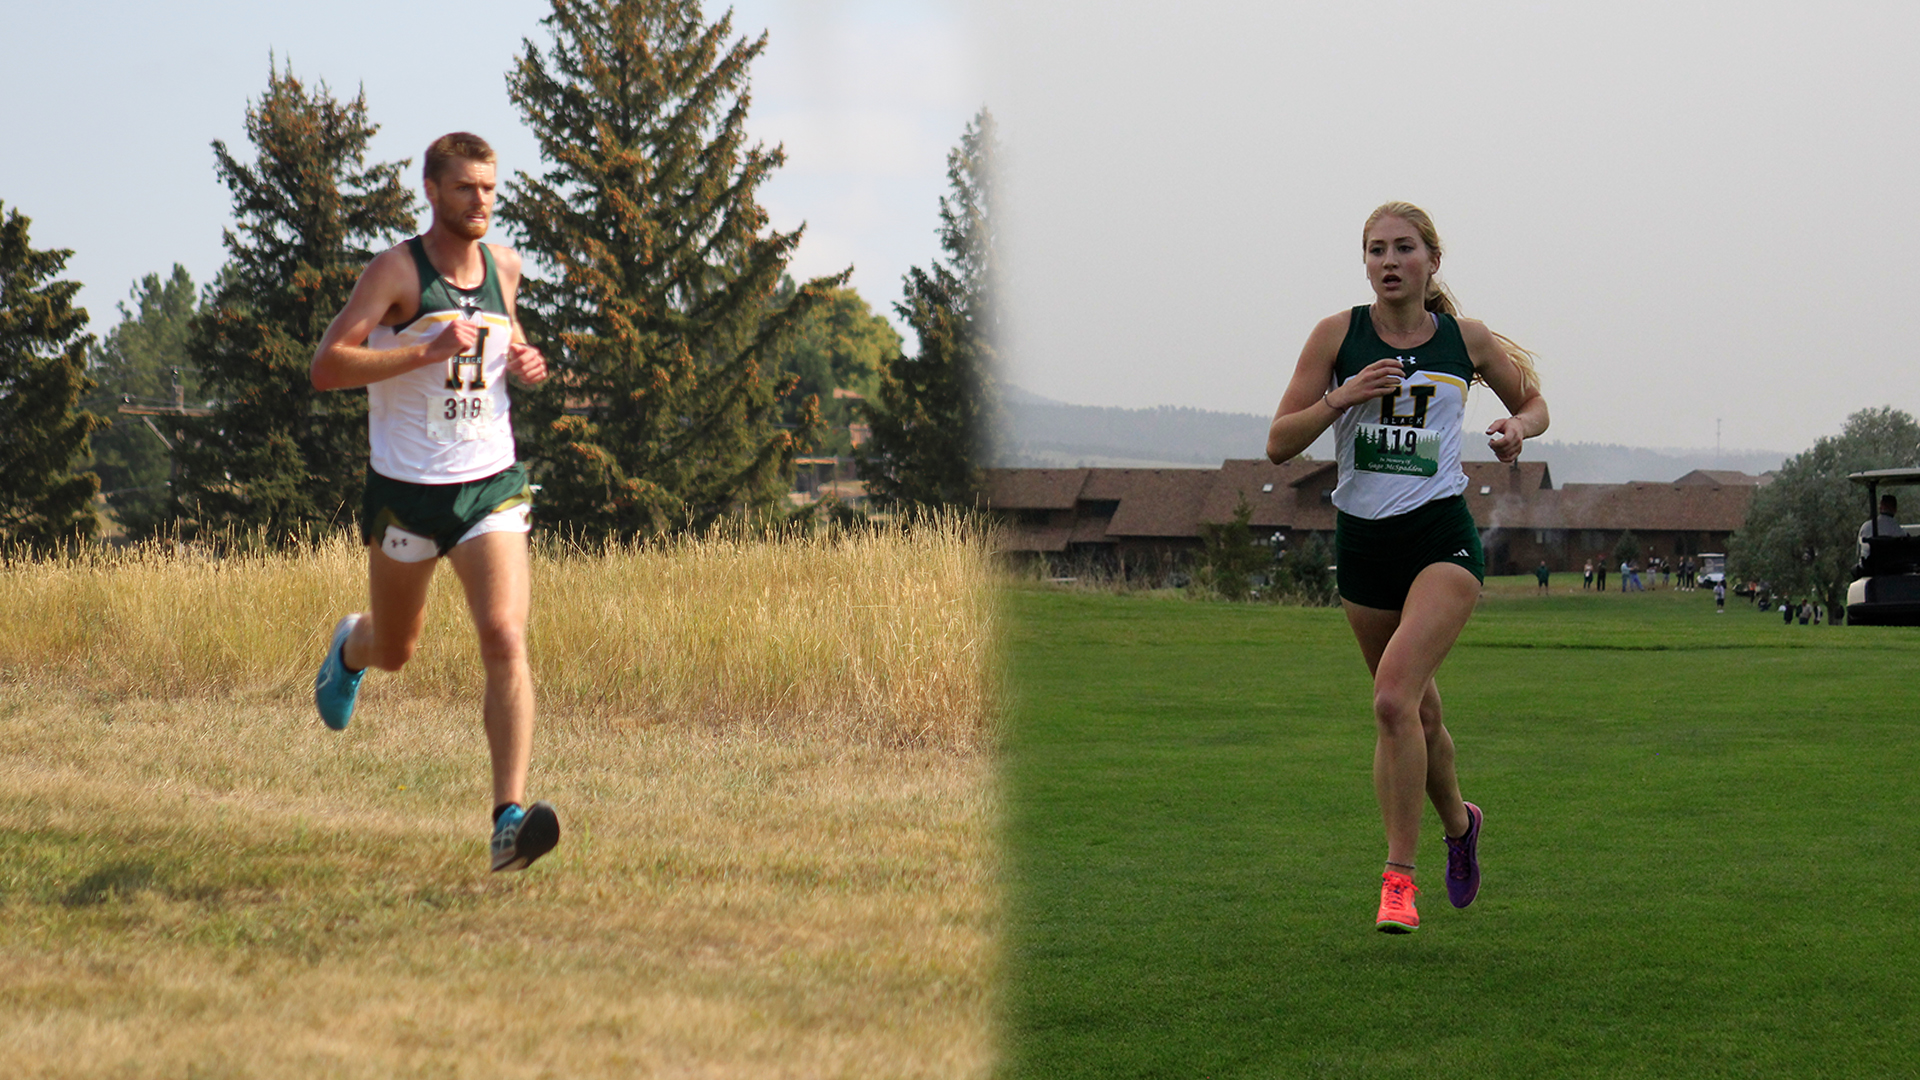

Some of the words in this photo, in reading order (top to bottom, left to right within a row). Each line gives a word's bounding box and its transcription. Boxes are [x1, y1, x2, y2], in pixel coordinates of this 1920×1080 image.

[444, 398, 482, 420] 319
[1382, 417, 1423, 425] BLACK
[1377, 427, 1417, 456] 119
